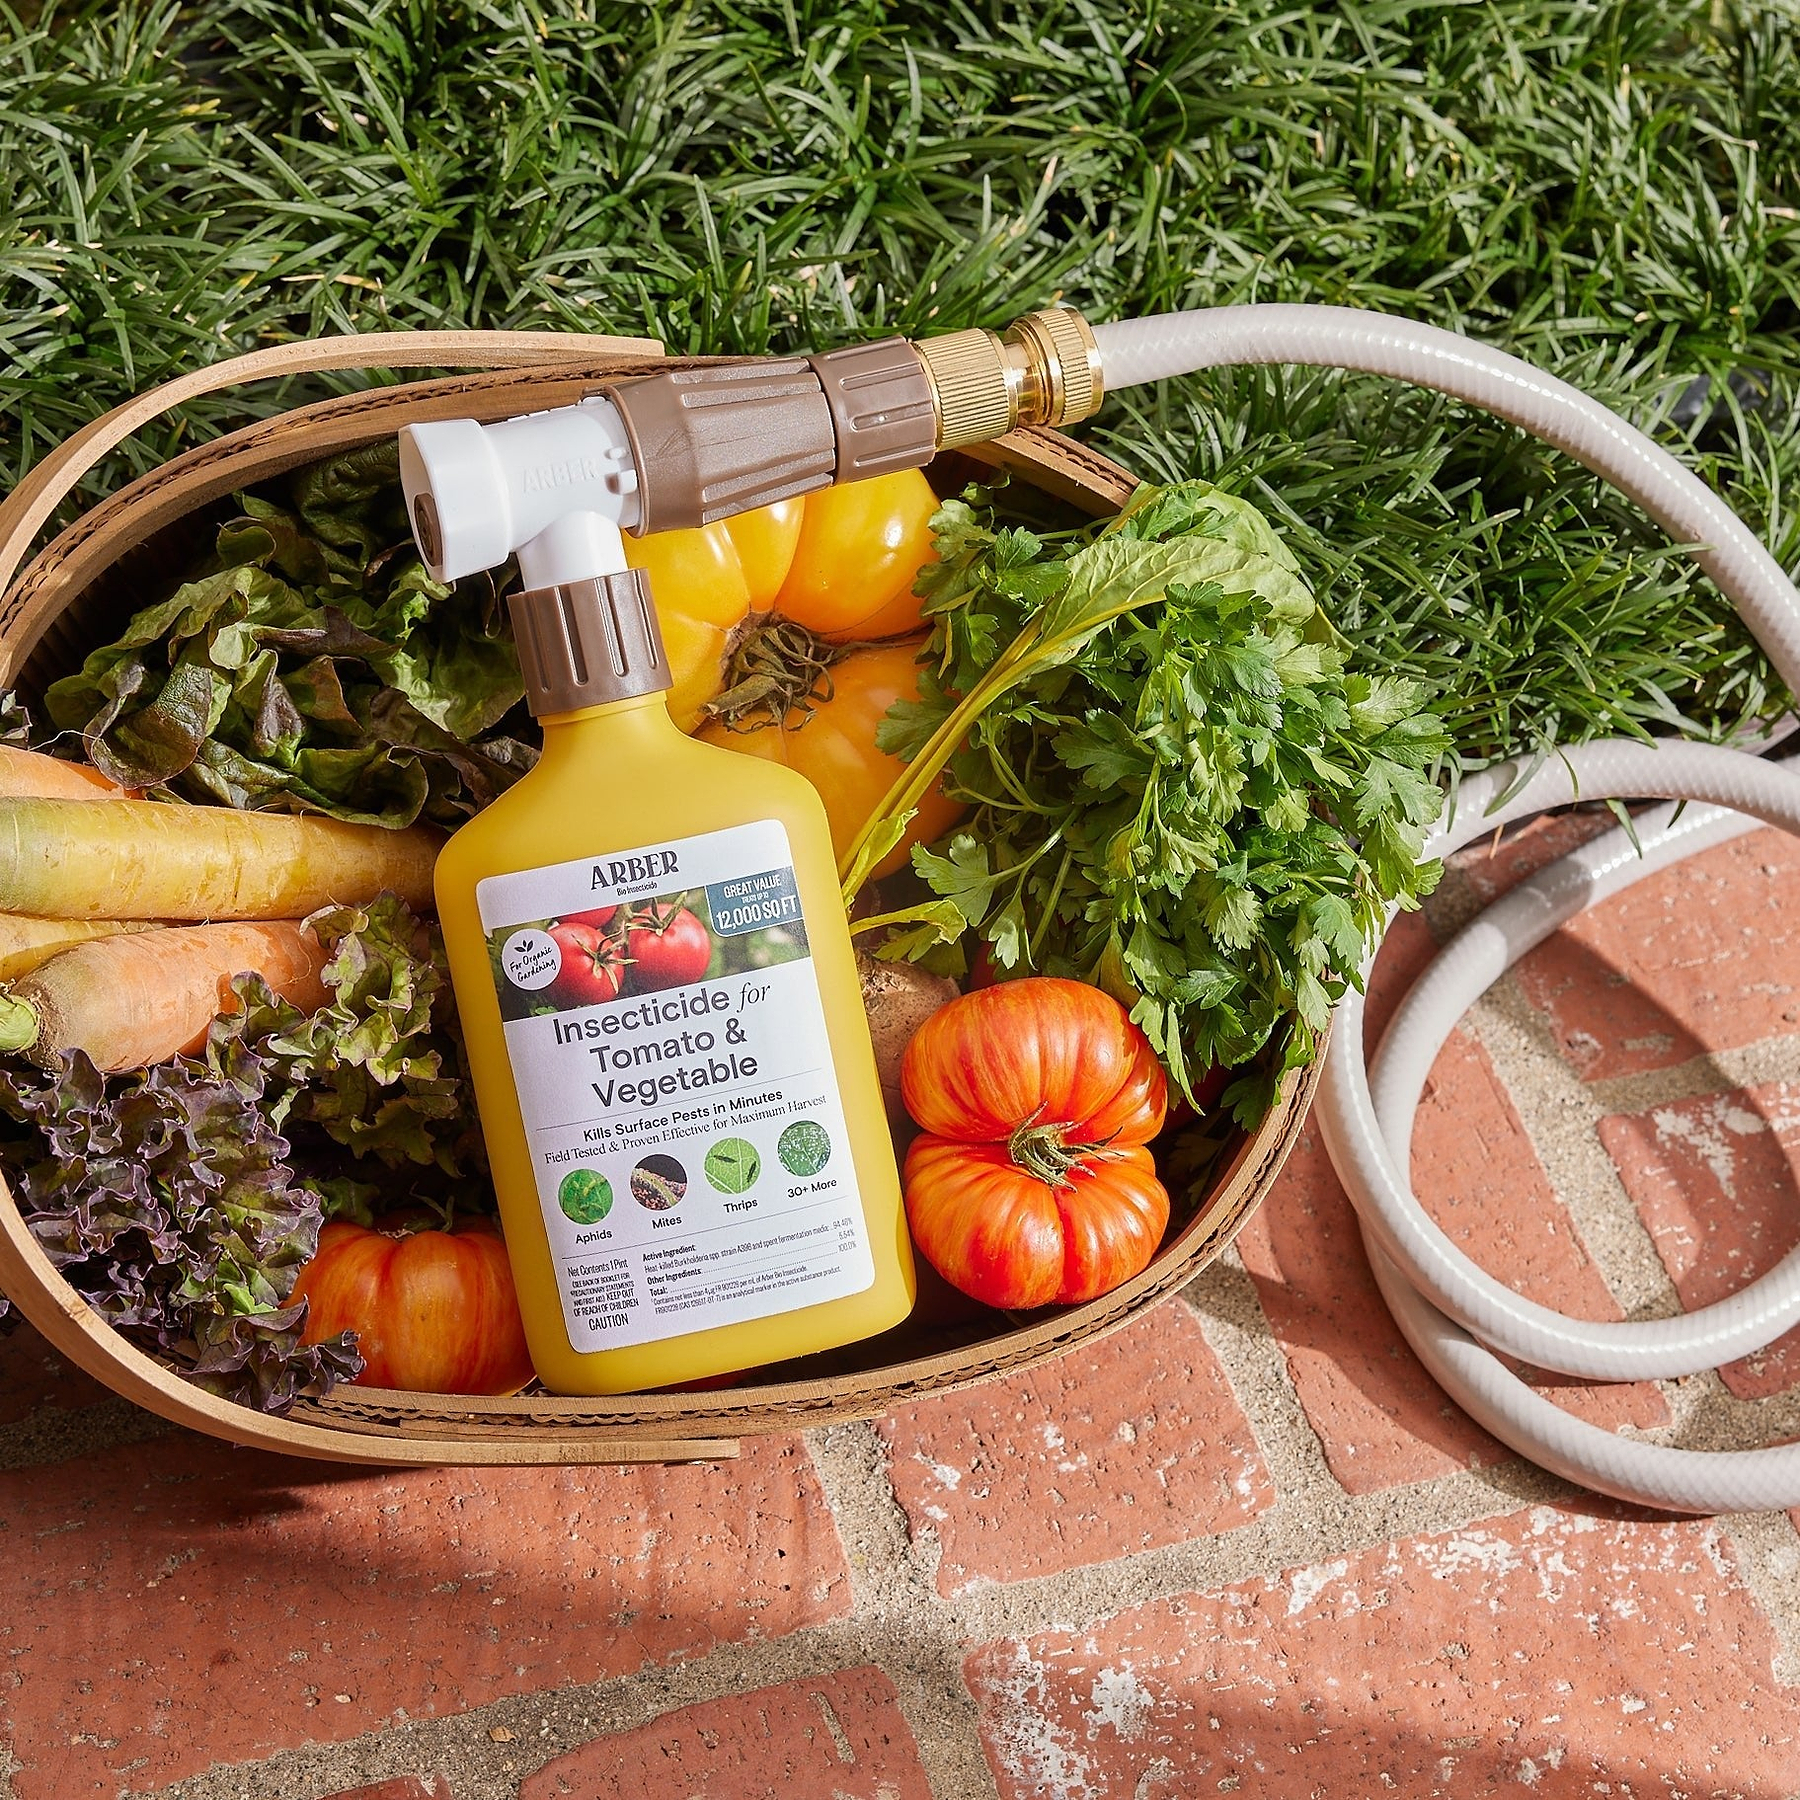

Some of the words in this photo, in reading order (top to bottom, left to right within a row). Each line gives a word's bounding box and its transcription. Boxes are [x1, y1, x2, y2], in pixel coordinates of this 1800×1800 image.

[523, 458, 596, 493] ARBER
[591, 851, 679, 890] ARBER
[724, 880, 752, 898] GREAT
[753, 874, 781, 891] VALUE
[716, 904, 761, 929] 12,000
[762, 899, 780, 919] SQ
[781, 895, 796, 915] FT
[510, 962, 522, 972] For
[523, 947, 552, 966] Organic
[518, 959, 556, 982] Gardening
[553, 988, 730, 1044] Insecticide
[737, 982, 771, 1012] for
[590, 1031, 714, 1072] Tomato
[725, 1017, 747, 1044] &
[591, 1053, 758, 1108] Vegetable
[584, 1128, 612, 1142] Kills
[615, 1117, 668, 1136] Surface
[672, 1108, 710, 1124] Pests
[713, 1104, 726, 1114] in
[729, 1090, 783, 1110] Minutes
[545, 1150, 570, 1164] Field
[571, 1144, 606, 1159] Tested
[609, 1141, 620, 1152] &
[622, 1135, 660, 1150] Proven
[662, 1123, 710, 1141] Effective
[713, 1118, 728, 1130] for
[731, 1108, 786, 1126] Maximum
[788, 1095, 827, 1112] Harvest
[788, 1186, 808, 1198] 30+
[811, 1179, 837, 1192] More
[724, 1200, 758, 1213] Thrips
[652, 1215, 682, 1230] Mites
[576, 1229, 613, 1245] Aphids
[568, 1266, 580, 1277] Net
[580, 1264, 610, 1276] Contents
[614, 1258, 628, 1270] Pint
[643, 1250, 662, 1262] Active
[646, 1276, 664, 1285] Other
[606, 1290, 621, 1301] KEEP
[622, 1288, 634, 1298] OUT
[574, 1308, 580, 1317] OF
[582, 1304, 601, 1316] REACH
[601, 1303, 608, 1312] OF
[609, 1298, 640, 1312] CHILDREN
[588, 1312, 629, 1331] CAUTION
